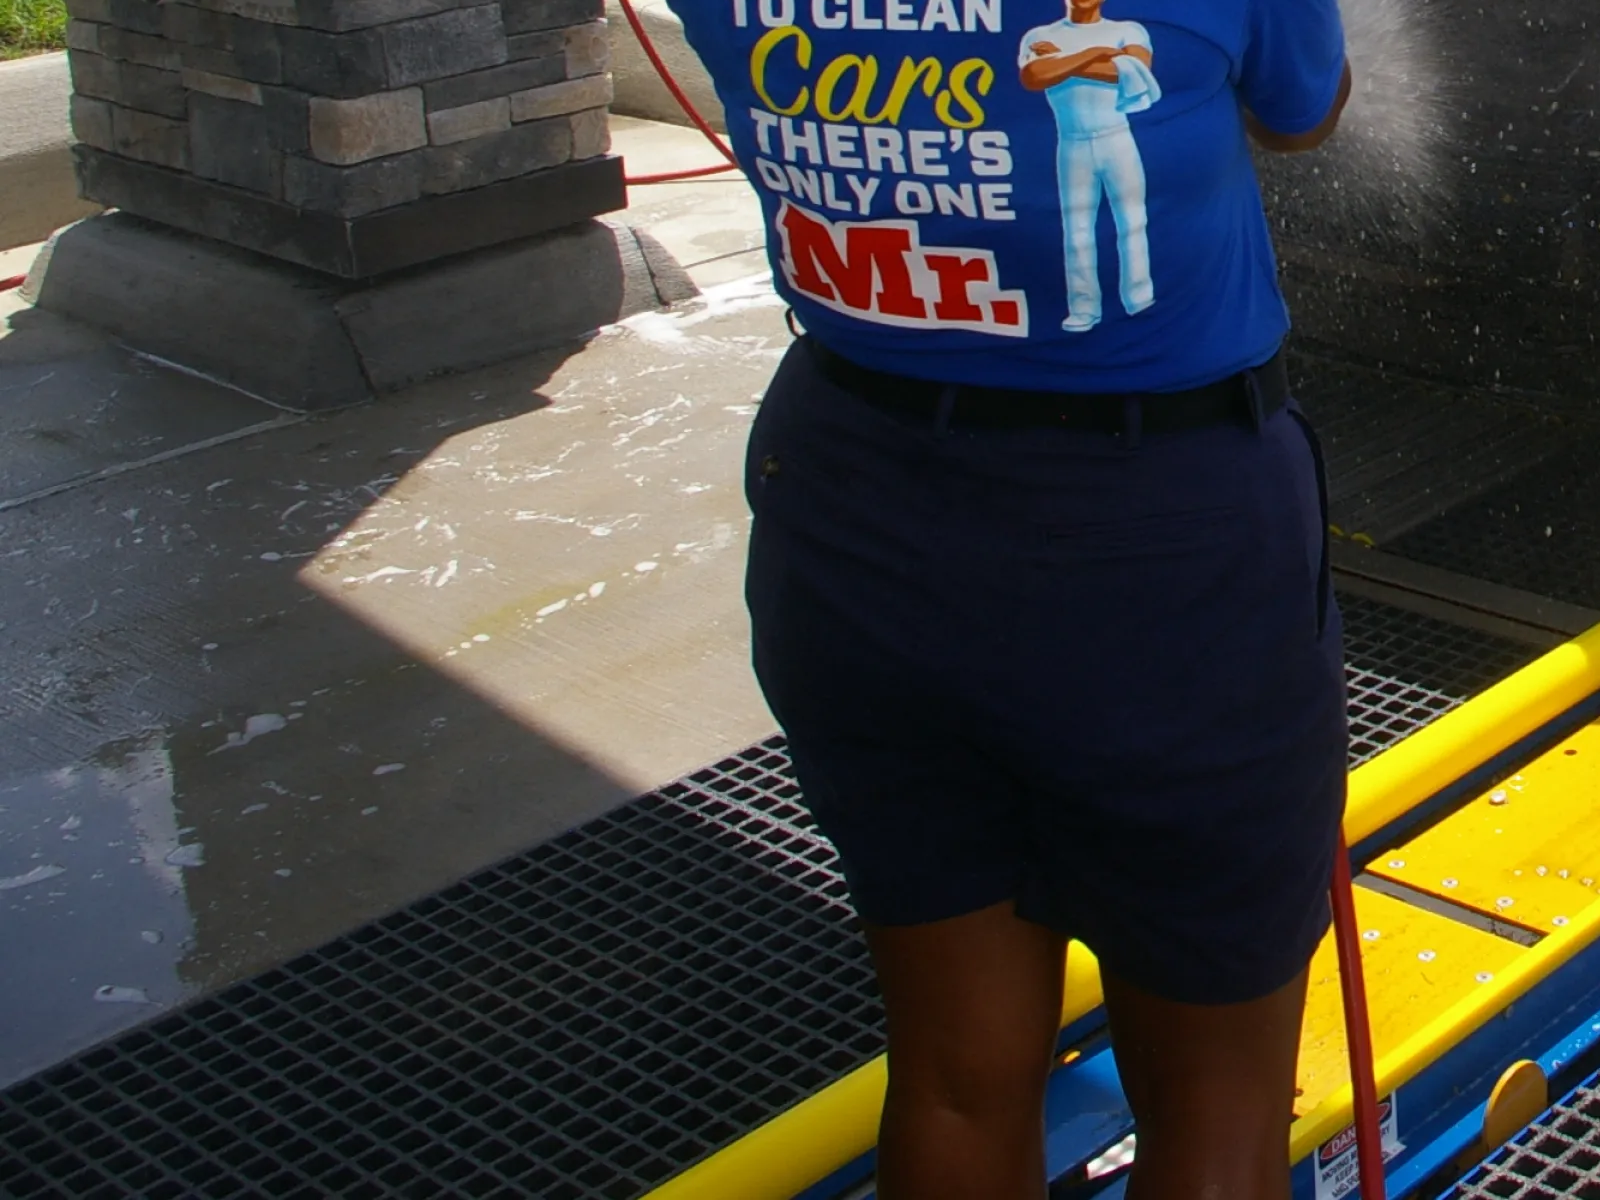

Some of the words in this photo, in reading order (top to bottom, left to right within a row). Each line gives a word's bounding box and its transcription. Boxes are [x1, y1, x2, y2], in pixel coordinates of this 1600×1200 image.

[750, 25, 995, 130] Cars
[749, 107, 1014, 177] THERE'S
[755, 156, 886, 216] ONLY
[896, 183, 1016, 222] ONE
[780, 201, 1023, 330] Mr.
